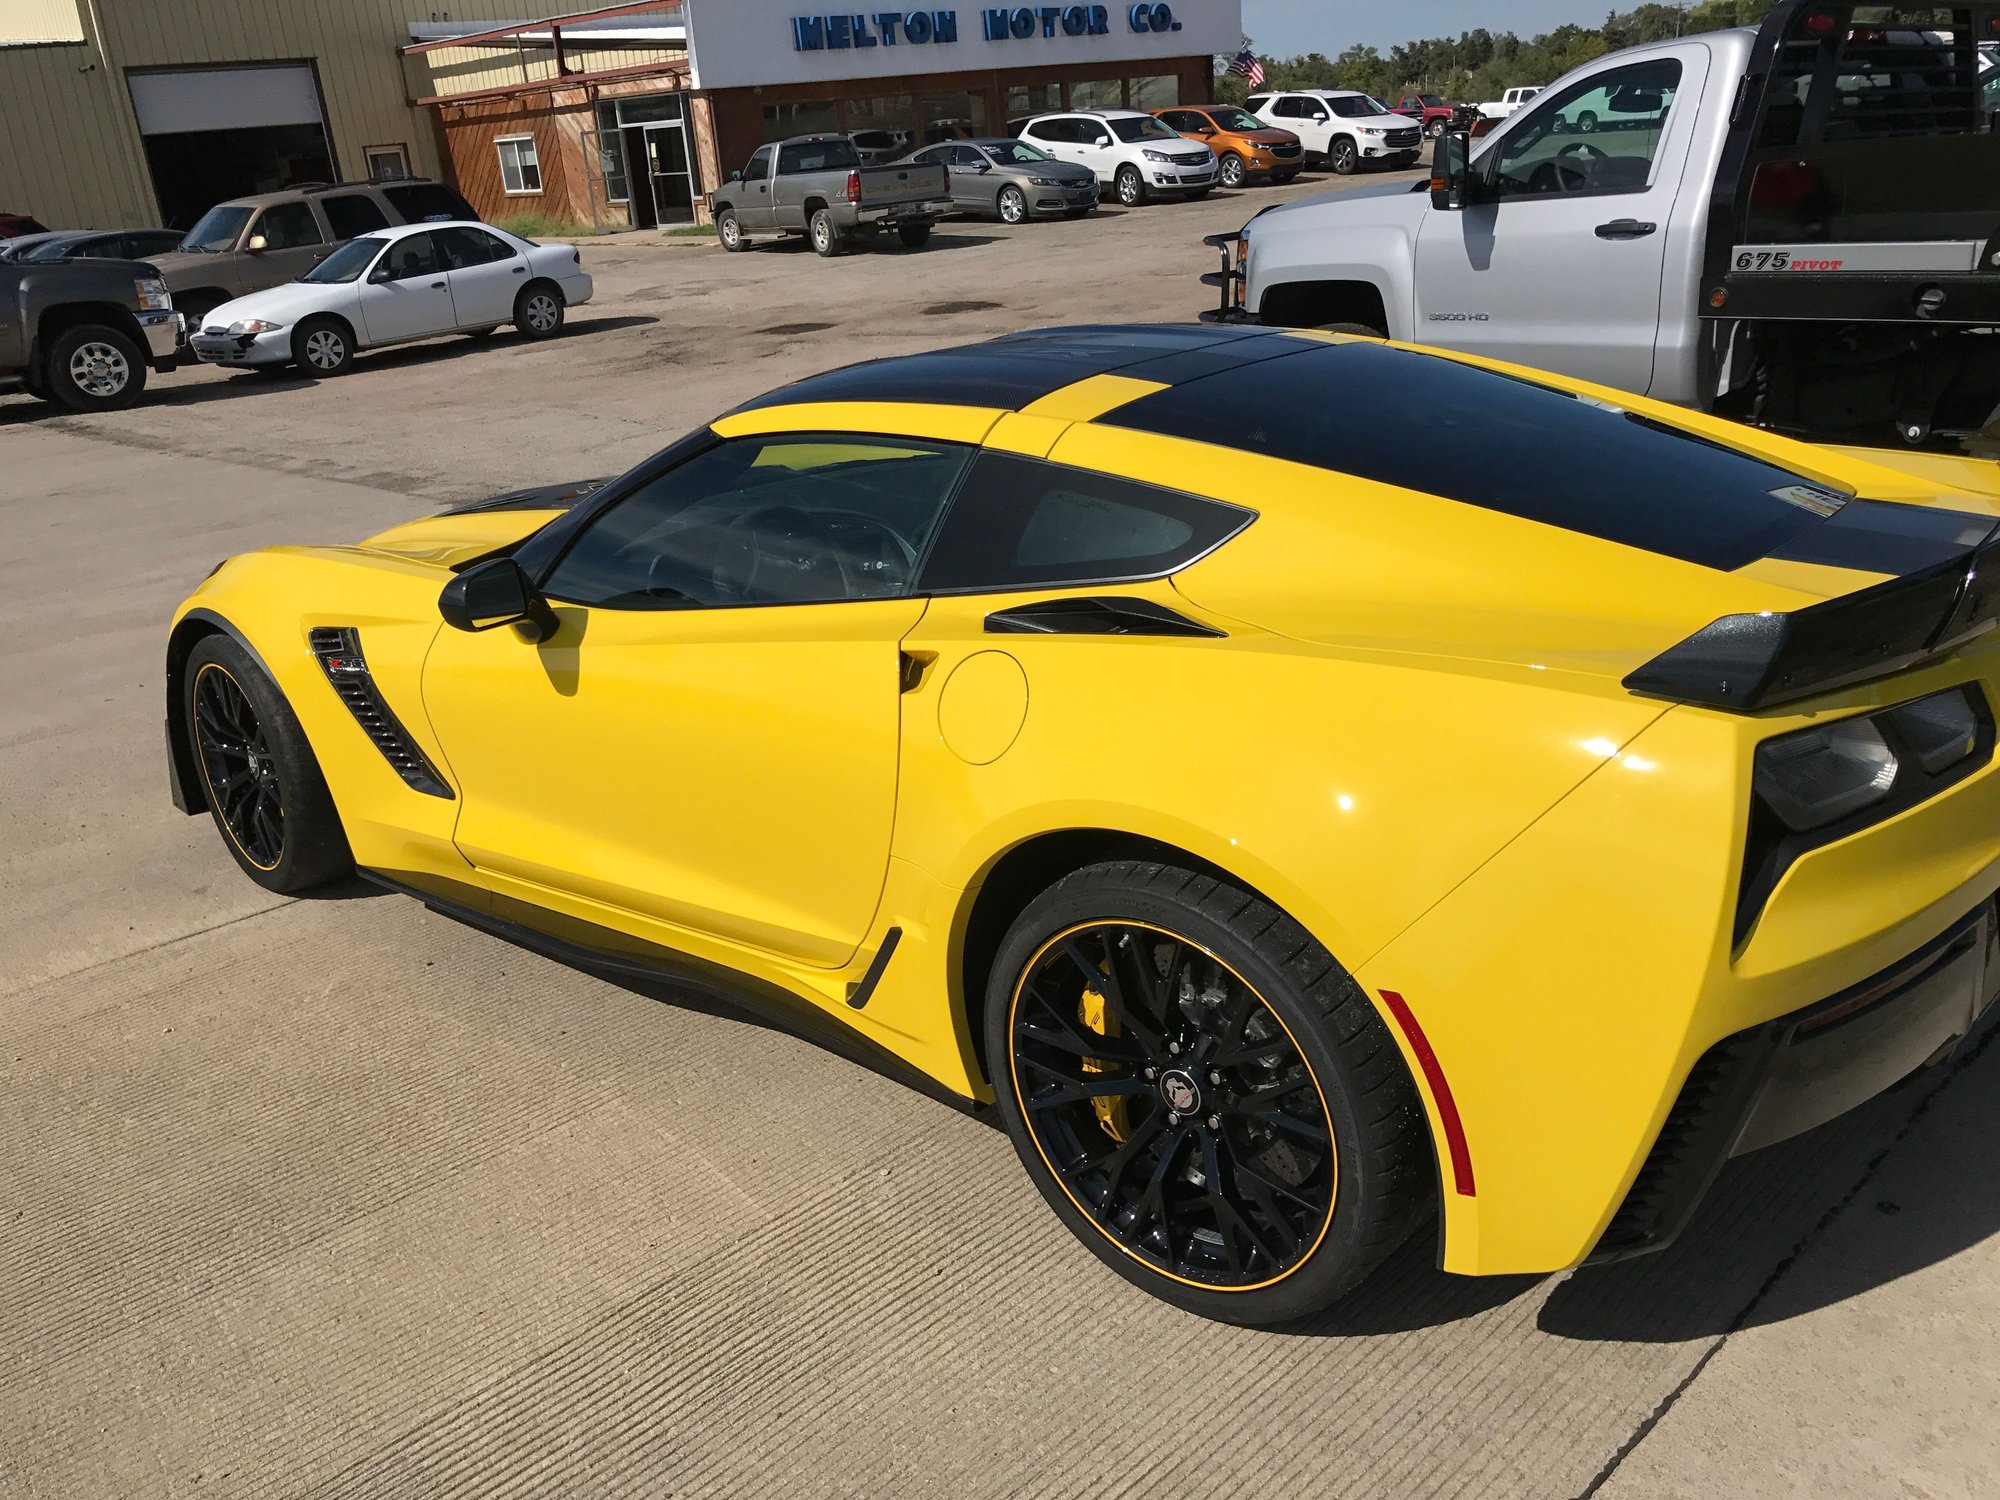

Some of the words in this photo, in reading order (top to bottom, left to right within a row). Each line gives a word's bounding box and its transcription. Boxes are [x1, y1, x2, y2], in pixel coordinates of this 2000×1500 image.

[791, 11, 957, 51] MELTON
[982, 5, 1110, 41] MOTOR
[1129, 3, 1182, 34] CO.
[1736, 252, 1790, 270] 675
[1789, 260, 1843, 271] PIVOT
